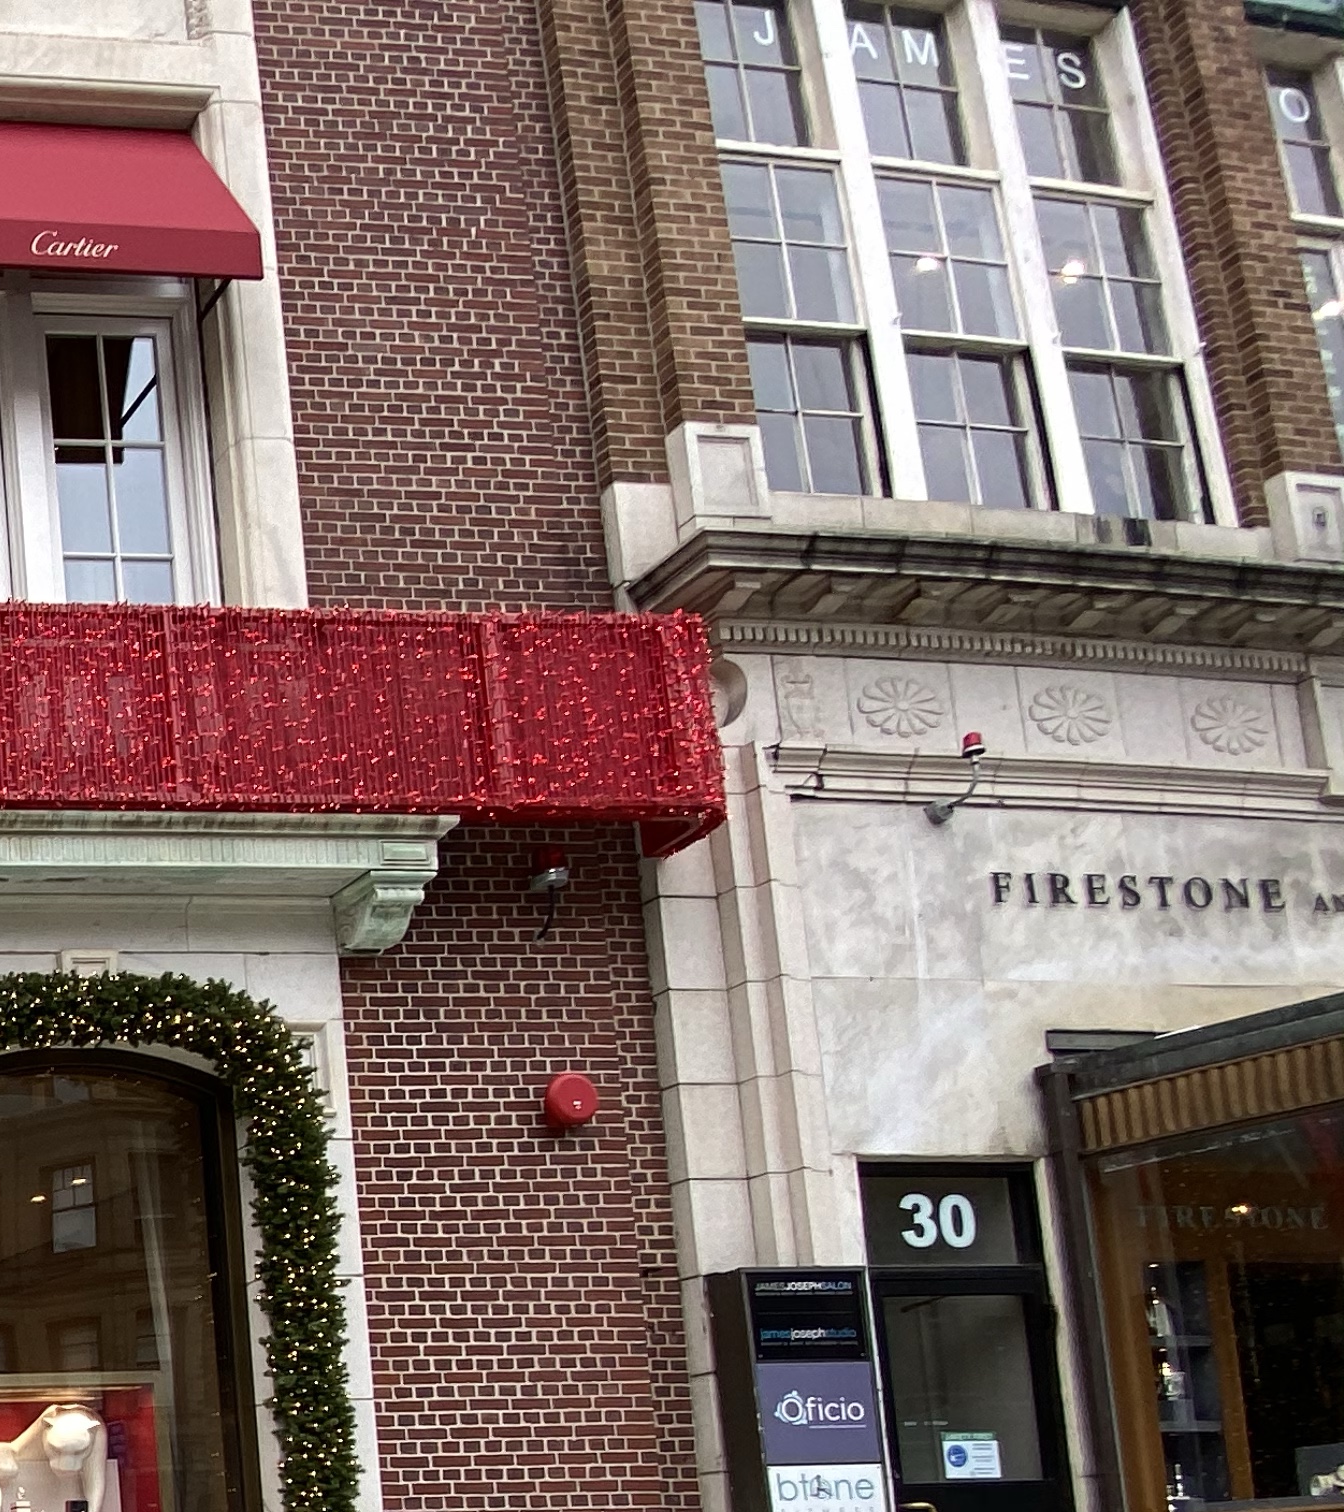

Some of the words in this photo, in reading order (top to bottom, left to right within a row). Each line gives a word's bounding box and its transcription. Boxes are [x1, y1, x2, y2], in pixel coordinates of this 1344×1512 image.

[30, 230, 119, 258] Cartier
[989, 871, 1287, 914] FIRESTONE
[898, 1192, 976, 1249] 30
[779, 1396, 865, 1423] Oficio
[775, 1472, 875, 1501] btone
